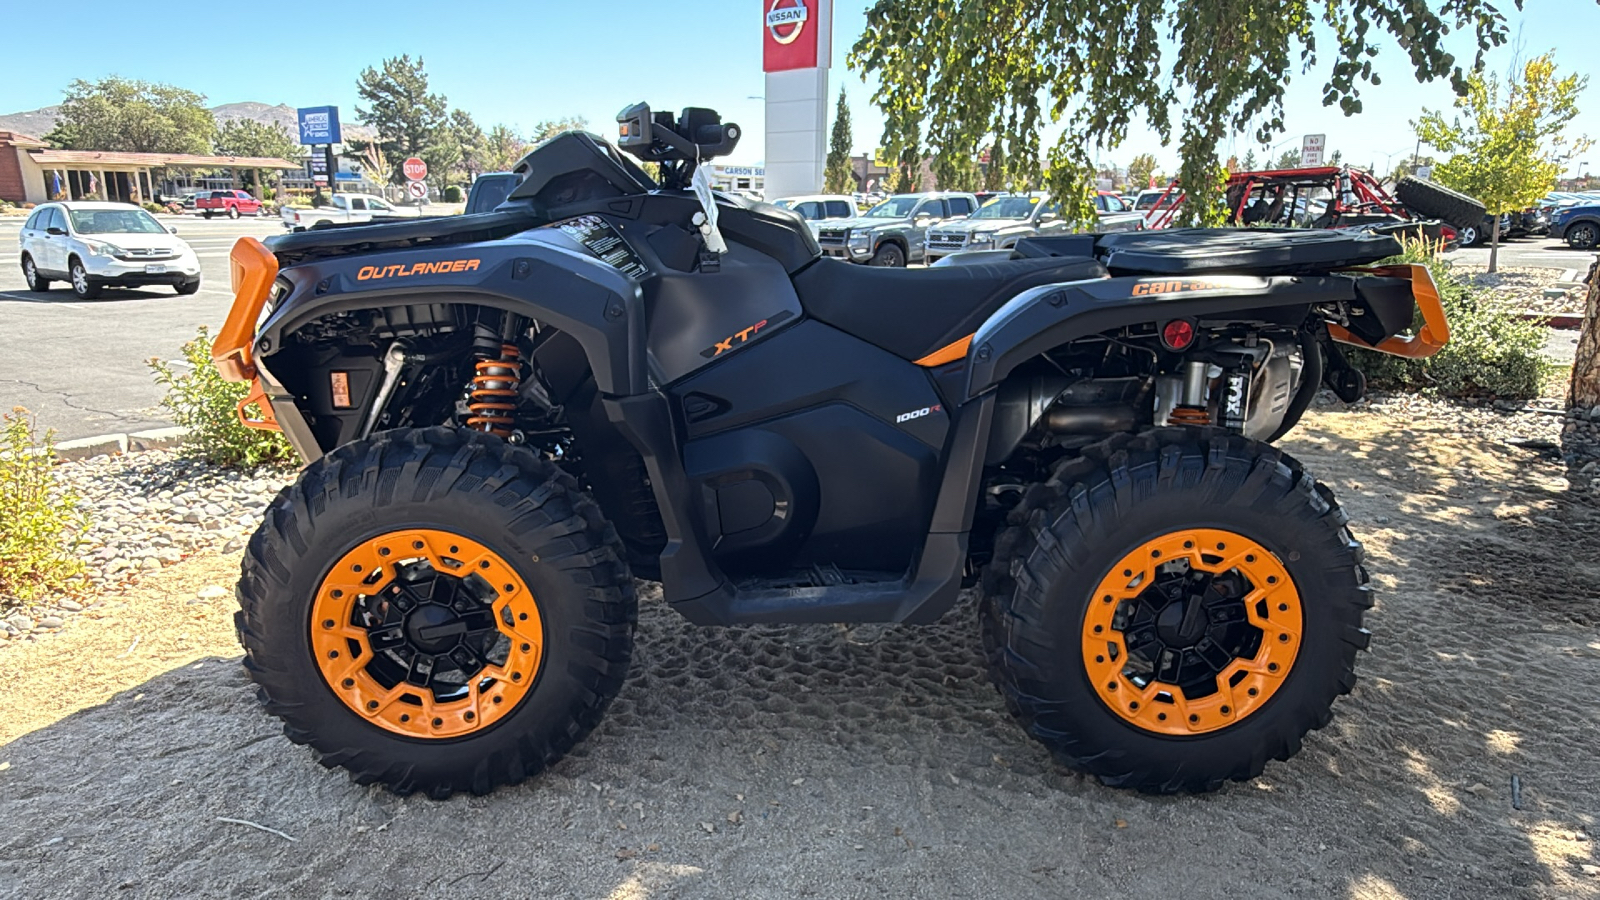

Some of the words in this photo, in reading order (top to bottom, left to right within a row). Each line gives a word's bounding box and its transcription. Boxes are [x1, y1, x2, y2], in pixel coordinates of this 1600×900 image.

[769, 10, 801, 22] NISSAN
[405, 164, 424, 174] STOP
[725, 167, 752, 175] CARSON
[358, 259, 480, 281] OUTLANDER
[1227, 376, 1244, 415] FOX
[896, 404, 941, 423] 1000R
